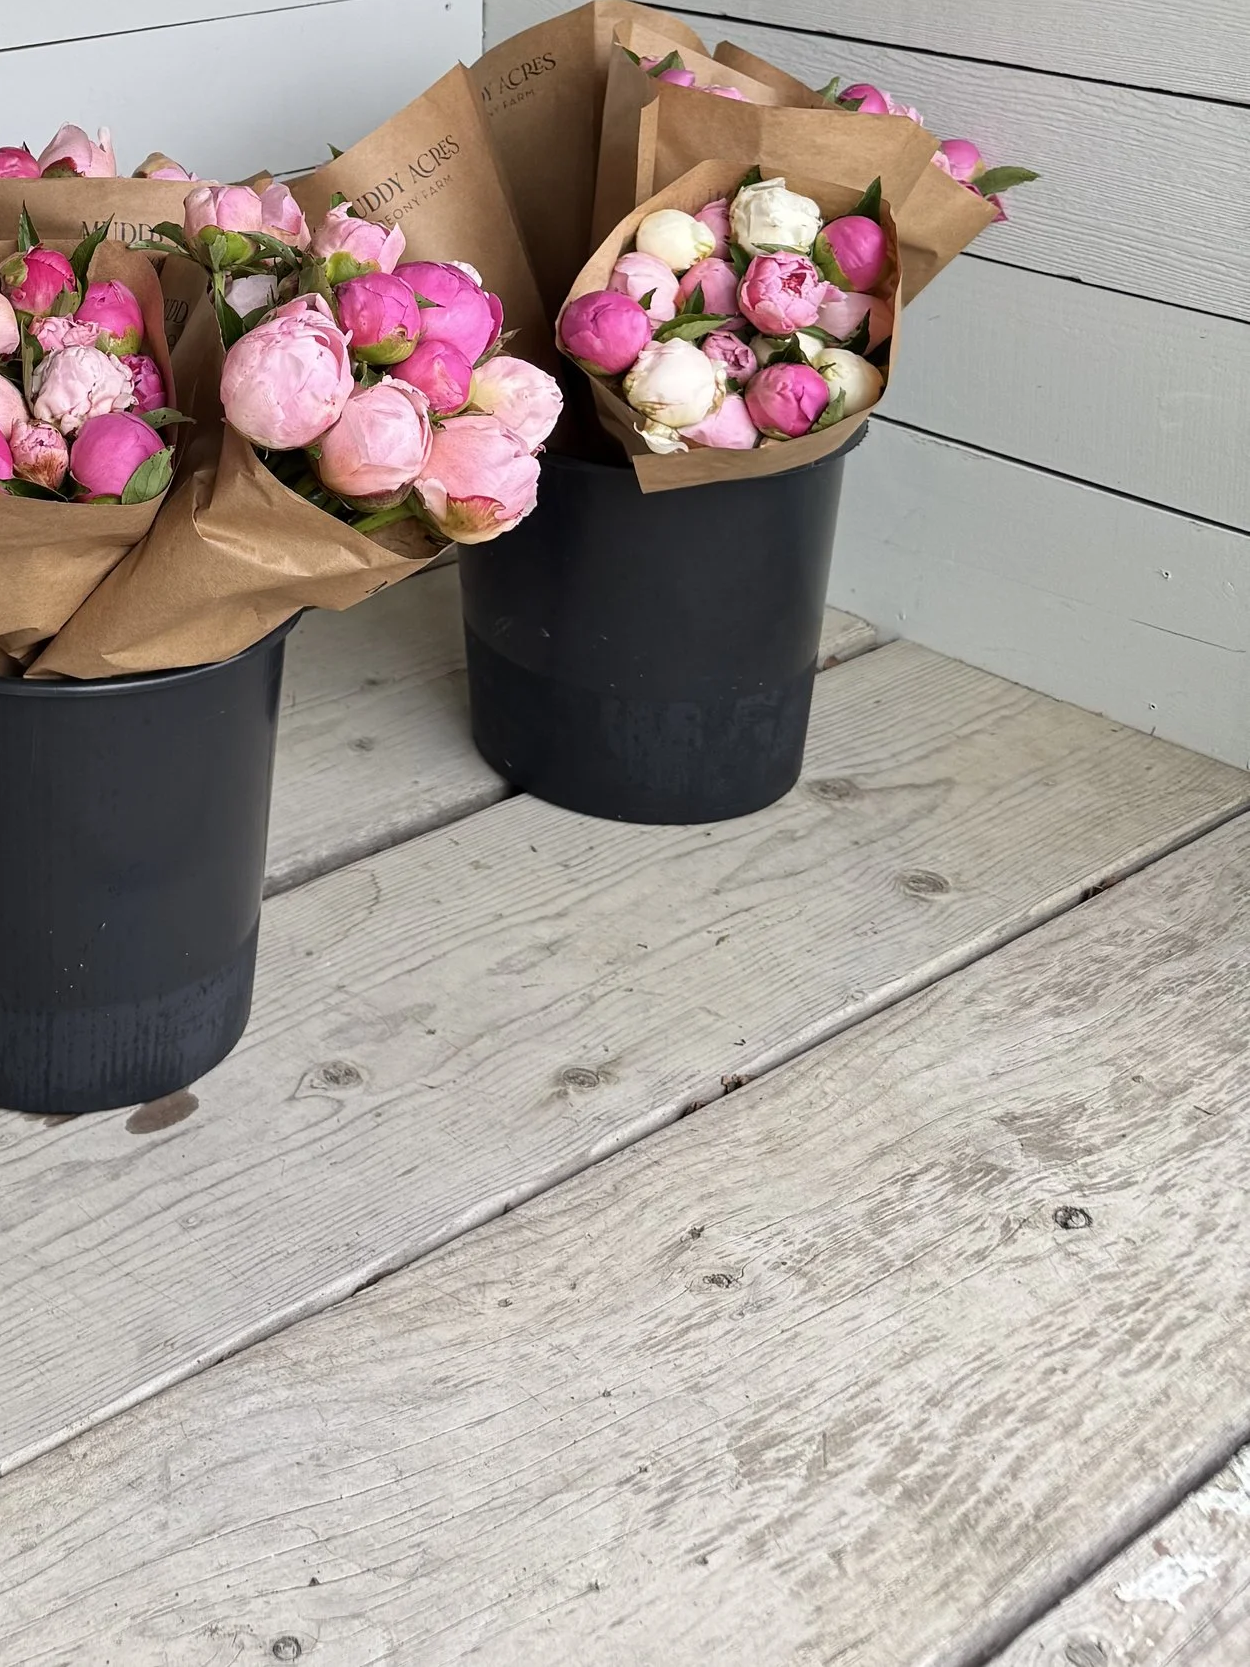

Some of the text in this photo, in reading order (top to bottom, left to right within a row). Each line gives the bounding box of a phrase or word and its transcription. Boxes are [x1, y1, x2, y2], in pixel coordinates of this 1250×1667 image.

[499, 52, 557, 94] ACRES
[351, 134, 460, 220] UDDY ACRES
[422, 174, 454, 201] FARM
